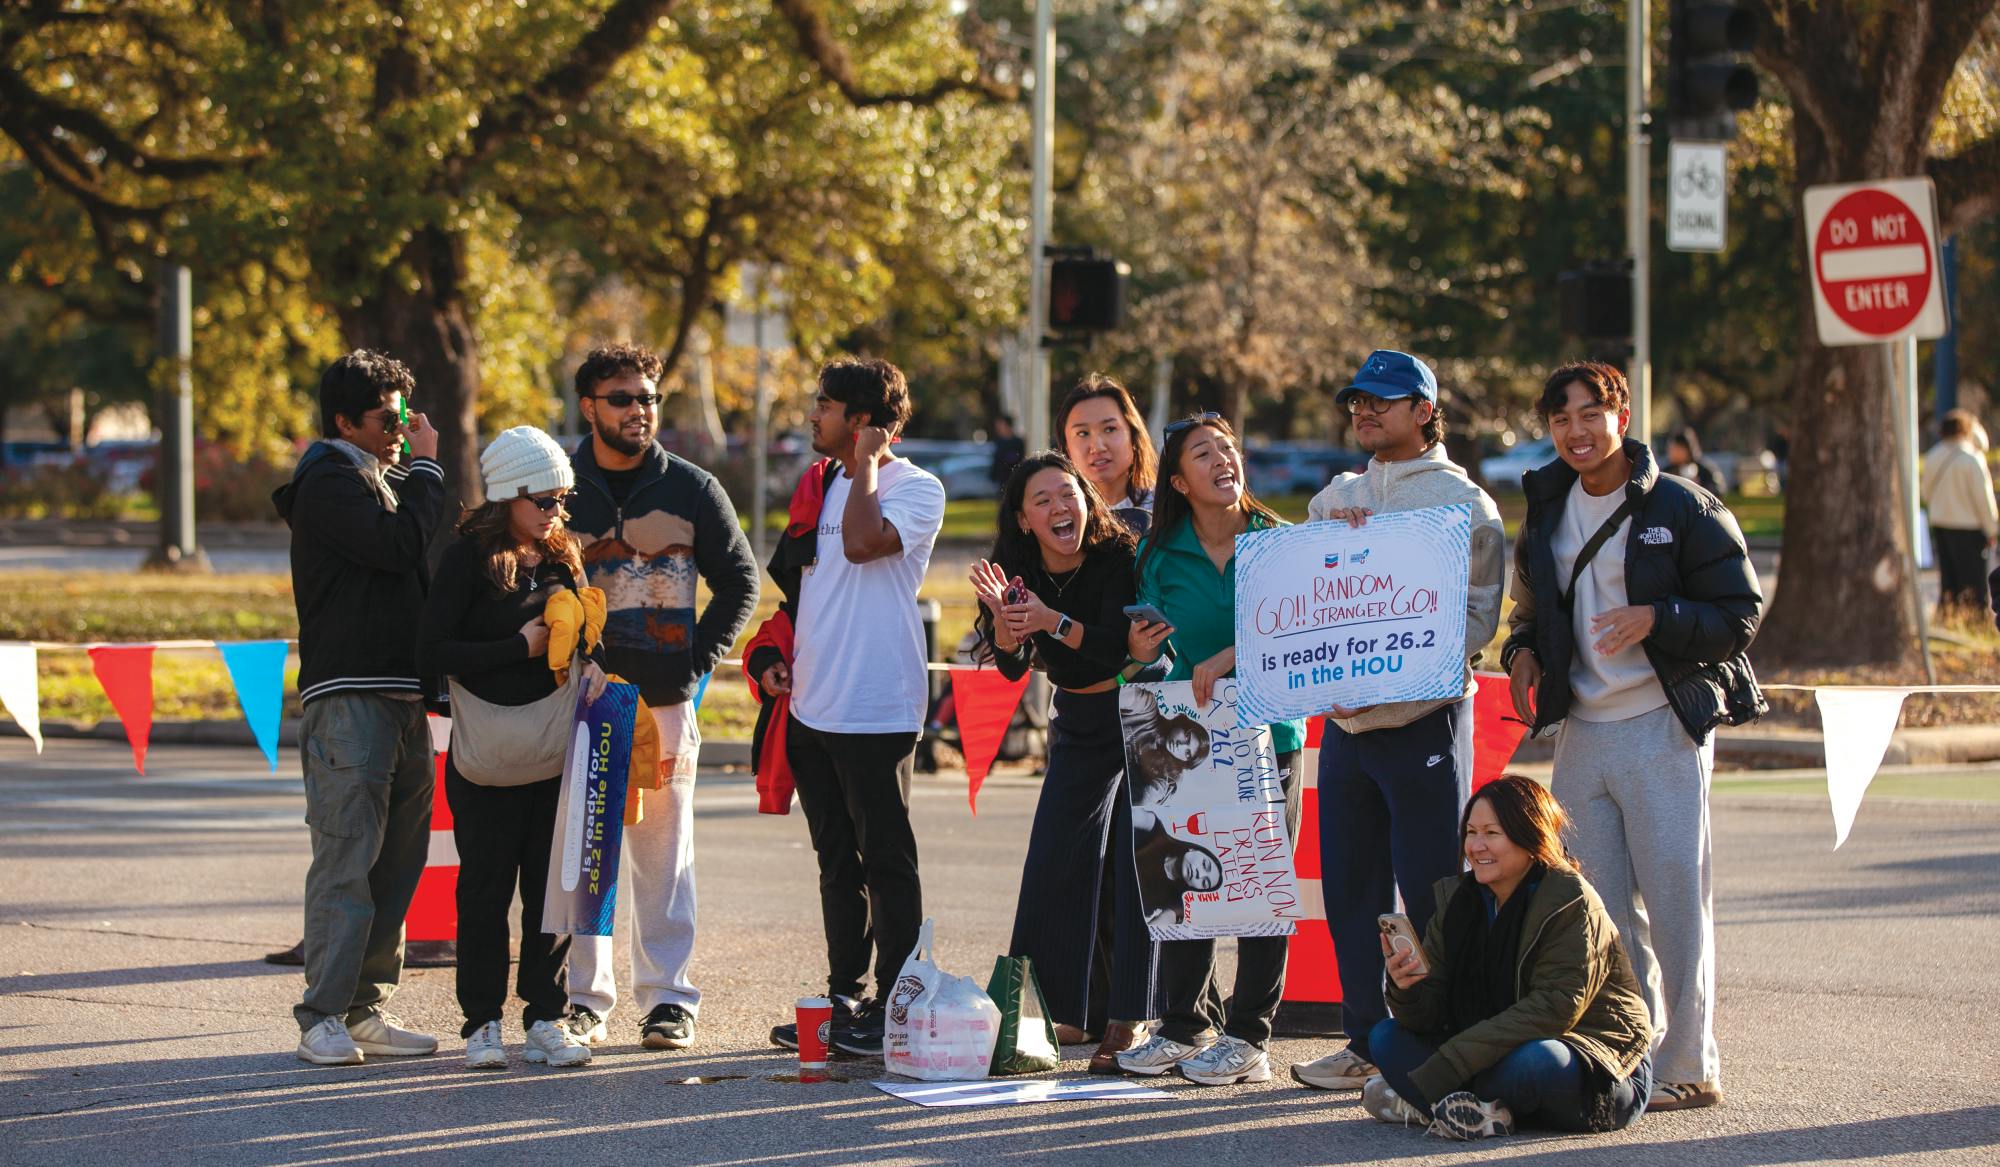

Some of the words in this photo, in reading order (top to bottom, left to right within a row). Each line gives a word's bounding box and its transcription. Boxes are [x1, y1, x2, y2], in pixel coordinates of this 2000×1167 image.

[1676, 209, 1718, 234] SIGNAL
[1830, 218, 1858, 245] DO
[1871, 213, 1908, 241] NOT
[1844, 281, 1909, 312] ENTER
[1256, 594, 1307, 635] GO!!
[1313, 574, 1393, 604] RANDOM
[1312, 602, 1387, 627] STRANGER
[1390, 585, 1438, 617] GO!!
[1262, 653, 1276, 672] is
[1283, 642, 1339, 668] ready
[1347, 637, 1378, 656] for
[1385, 629, 1435, 651] 26.2
[1288, 671, 1305, 689] in
[1312, 664, 1344, 685] the
[1351, 654, 1403, 678] HOU
[1208, 698, 1223, 718] A
[589, 748, 600, 780] for
[599, 721, 612, 773] HOU
[1211, 729, 1234, 769] 26.2
[1255, 746, 1279, 796] SCALE
[585, 787, 599, 849] ready
[595, 783, 607, 816] the
[593, 821, 604, 841] in
[1251, 811, 1286, 862] RUN
[582, 856, 591, 873] is
[589, 848, 601, 896] 26.2
[1213, 831, 1243, 902] LATER!
[1232, 828, 1263, 899] DRINKS
[1263, 870, 1302, 918] NOW
